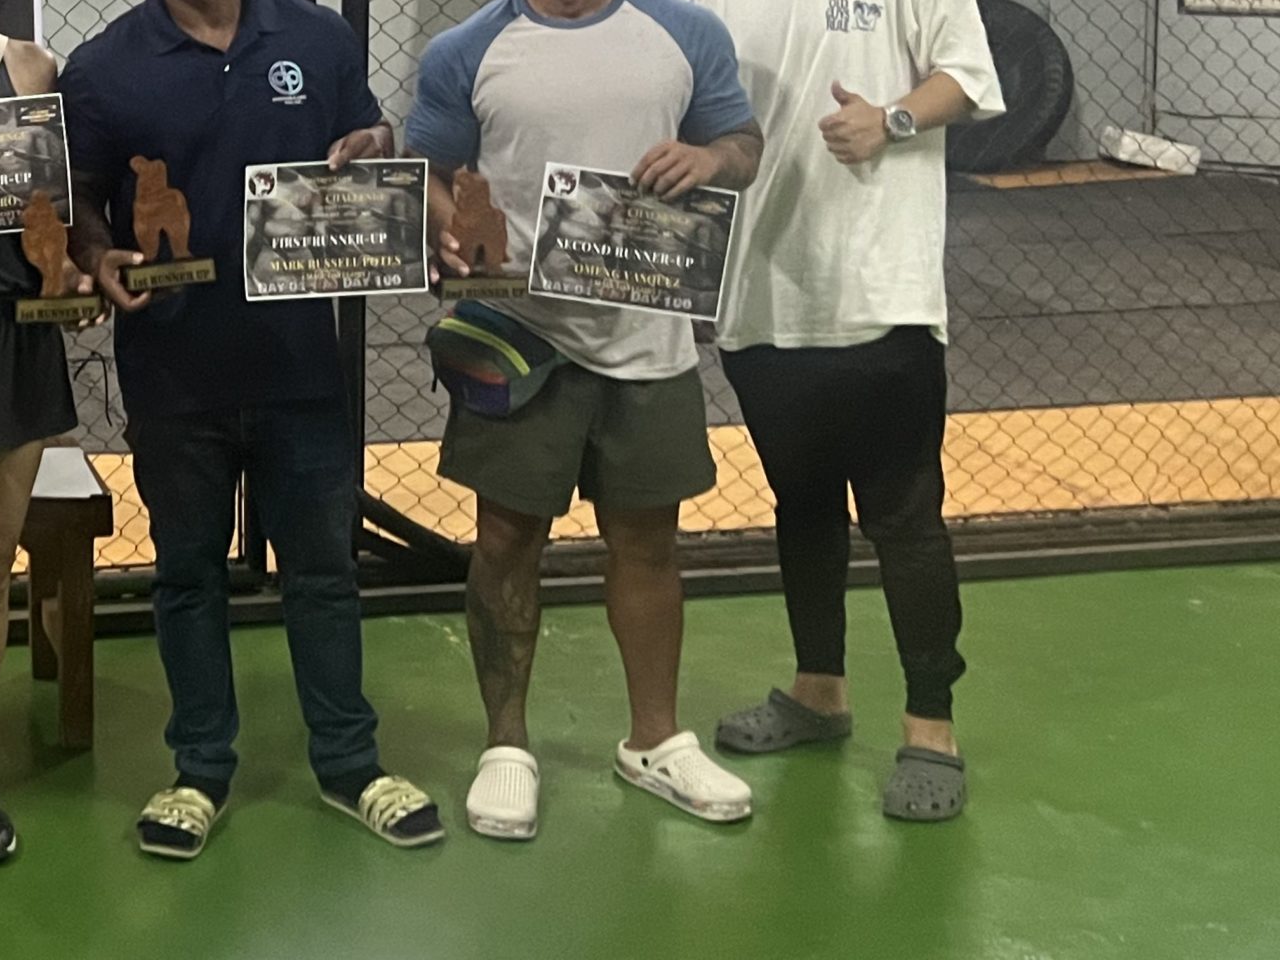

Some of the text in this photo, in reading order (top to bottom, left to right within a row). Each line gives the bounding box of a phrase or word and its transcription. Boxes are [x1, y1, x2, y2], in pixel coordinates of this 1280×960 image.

[272, 233, 388, 249] FIRST RUNNER-UP
[556, 237, 695, 269] SECOND RUNNER-UP
[270, 259, 305, 272] MARK
[308, 256, 358, 270] RUSSELL
[196, 269, 210, 280] UP
[342, 276, 370, 289] DAY
[375, 274, 402, 287] 100
[257, 282, 286, 294] DAY
[664, 296, 693, 310] 100
